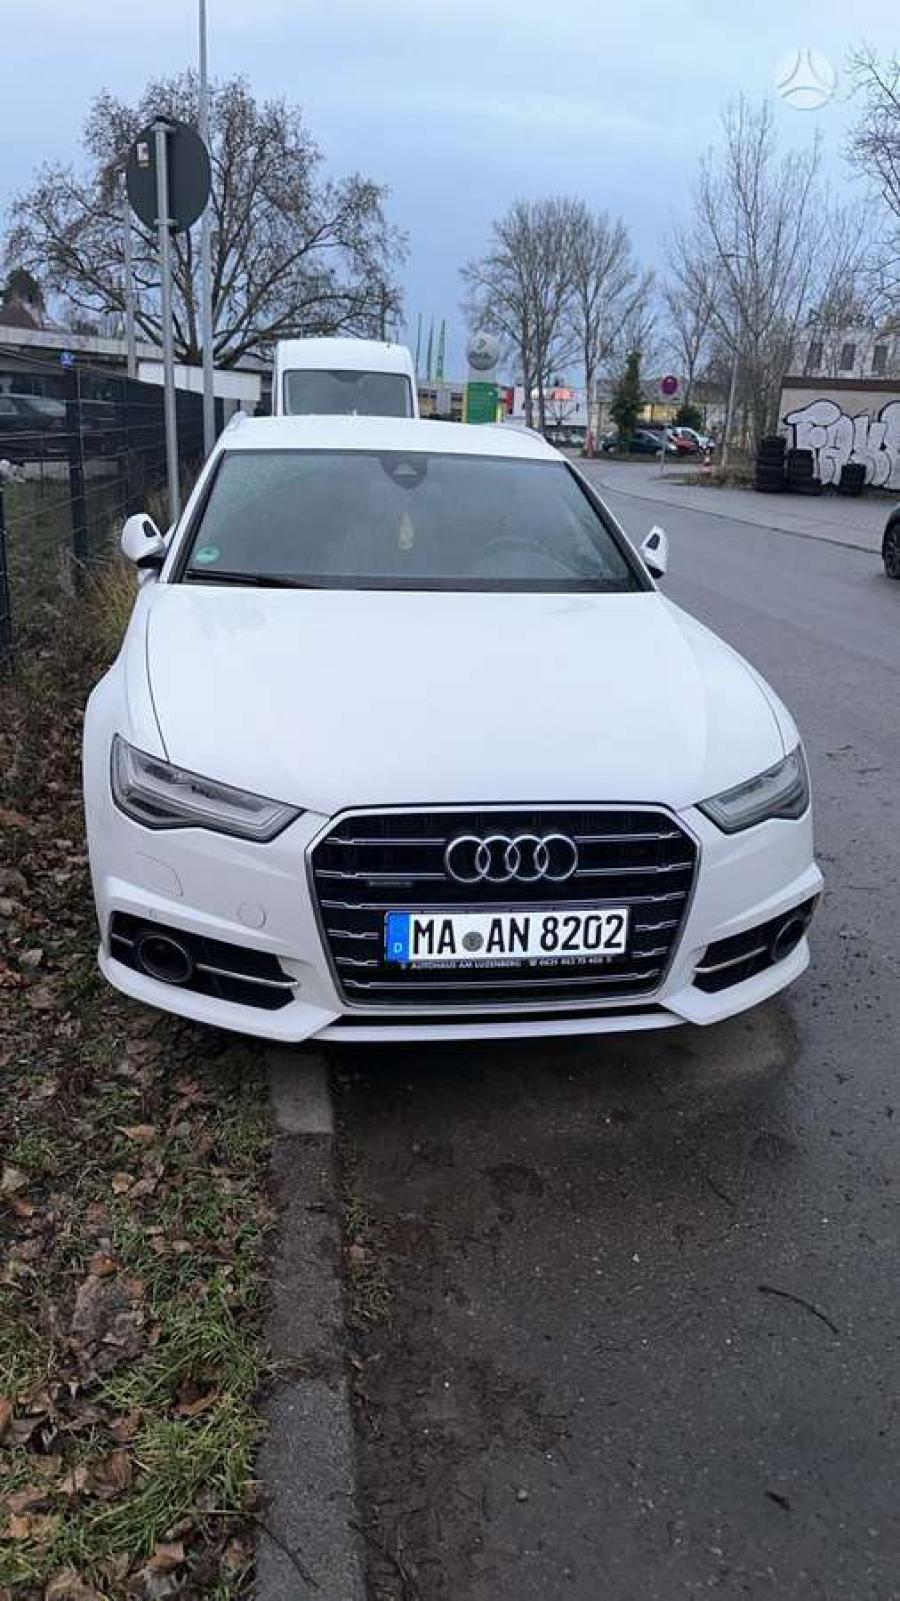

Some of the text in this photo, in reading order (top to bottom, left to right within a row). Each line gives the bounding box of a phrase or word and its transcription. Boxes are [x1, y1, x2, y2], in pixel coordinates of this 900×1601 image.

[394, 913, 625, 954] D MA AN 8202
